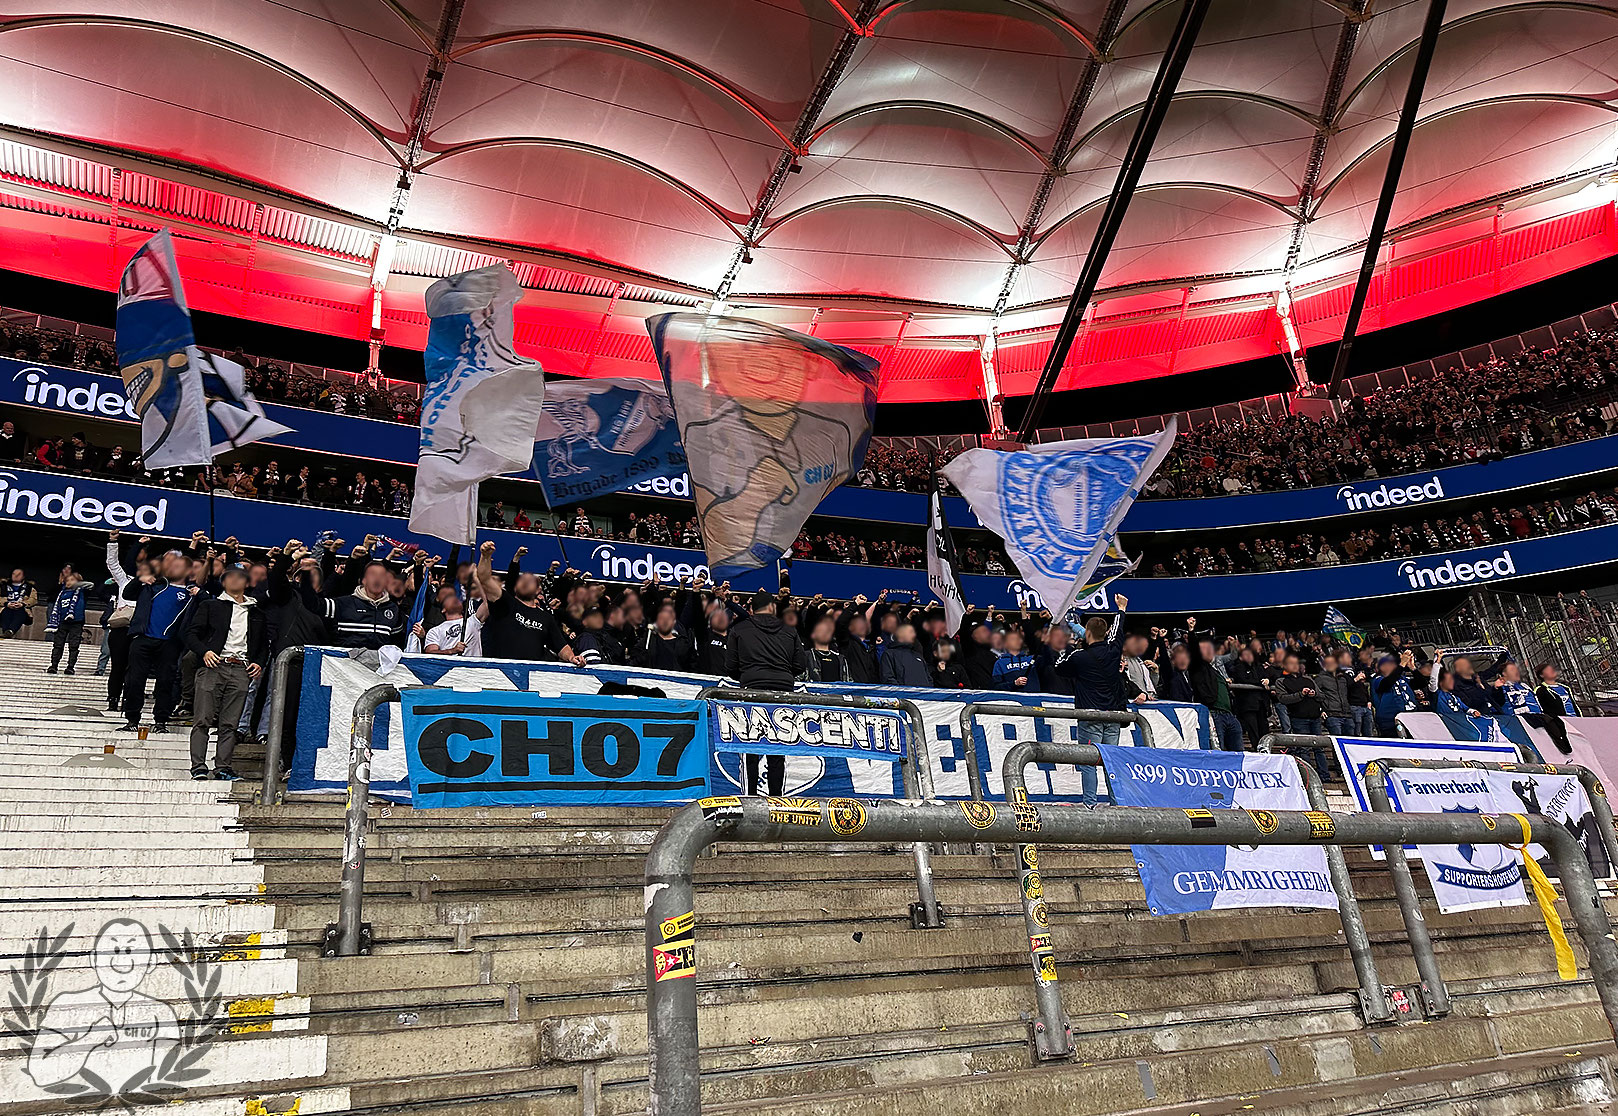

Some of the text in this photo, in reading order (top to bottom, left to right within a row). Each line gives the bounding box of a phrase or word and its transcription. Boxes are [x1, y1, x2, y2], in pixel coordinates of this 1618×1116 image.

[551, 473, 618, 498] Brigade
[1342, 476, 1445, 511] indeed
[1405, 549, 1516, 588] indeed
[715, 703, 901, 753] NASCENTI
[417, 717, 696, 779] CH07
[1125, 763, 1290, 790] 1899 SUPPORTER
[1401, 779, 1489, 796] Fanverband
[770, 812, 822, 827] THE UNITY
[1172, 869, 1334, 896] GEMMRIGHEIM
